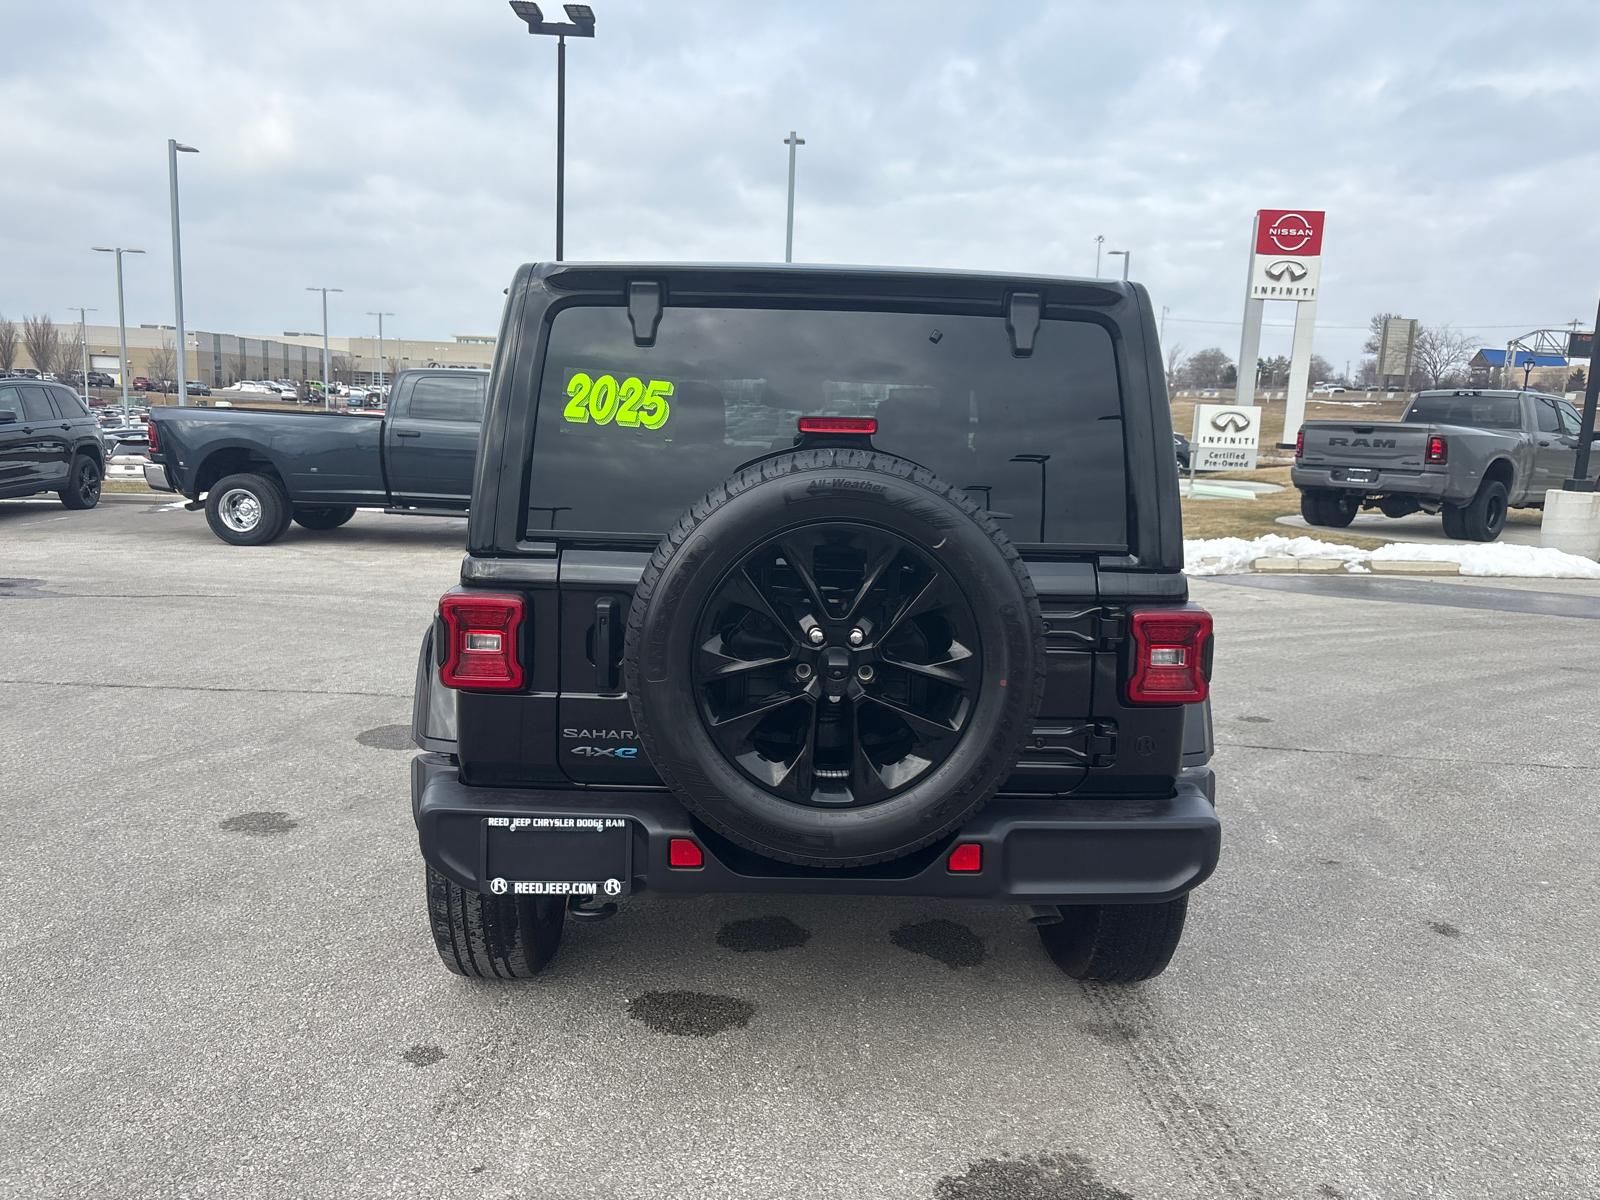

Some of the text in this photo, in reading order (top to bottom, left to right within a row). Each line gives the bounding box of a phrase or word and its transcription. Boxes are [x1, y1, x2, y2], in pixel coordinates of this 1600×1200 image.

[1269, 228, 1313, 236] NISSAN
[1254, 286, 1315, 296] INFINITI
[564, 373, 674, 430] 2025
[1202, 436, 1255, 445] INFINITI
[1328, 437, 1396, 448] RAM
[1209, 451, 1246, 460] Certified
[808, 478, 888, 493] All-Weather
[488, 817, 625, 828] REED JEEP CHRYSLER DODGE RAM
[514, 882, 597, 895] REEDJEEP.COM
